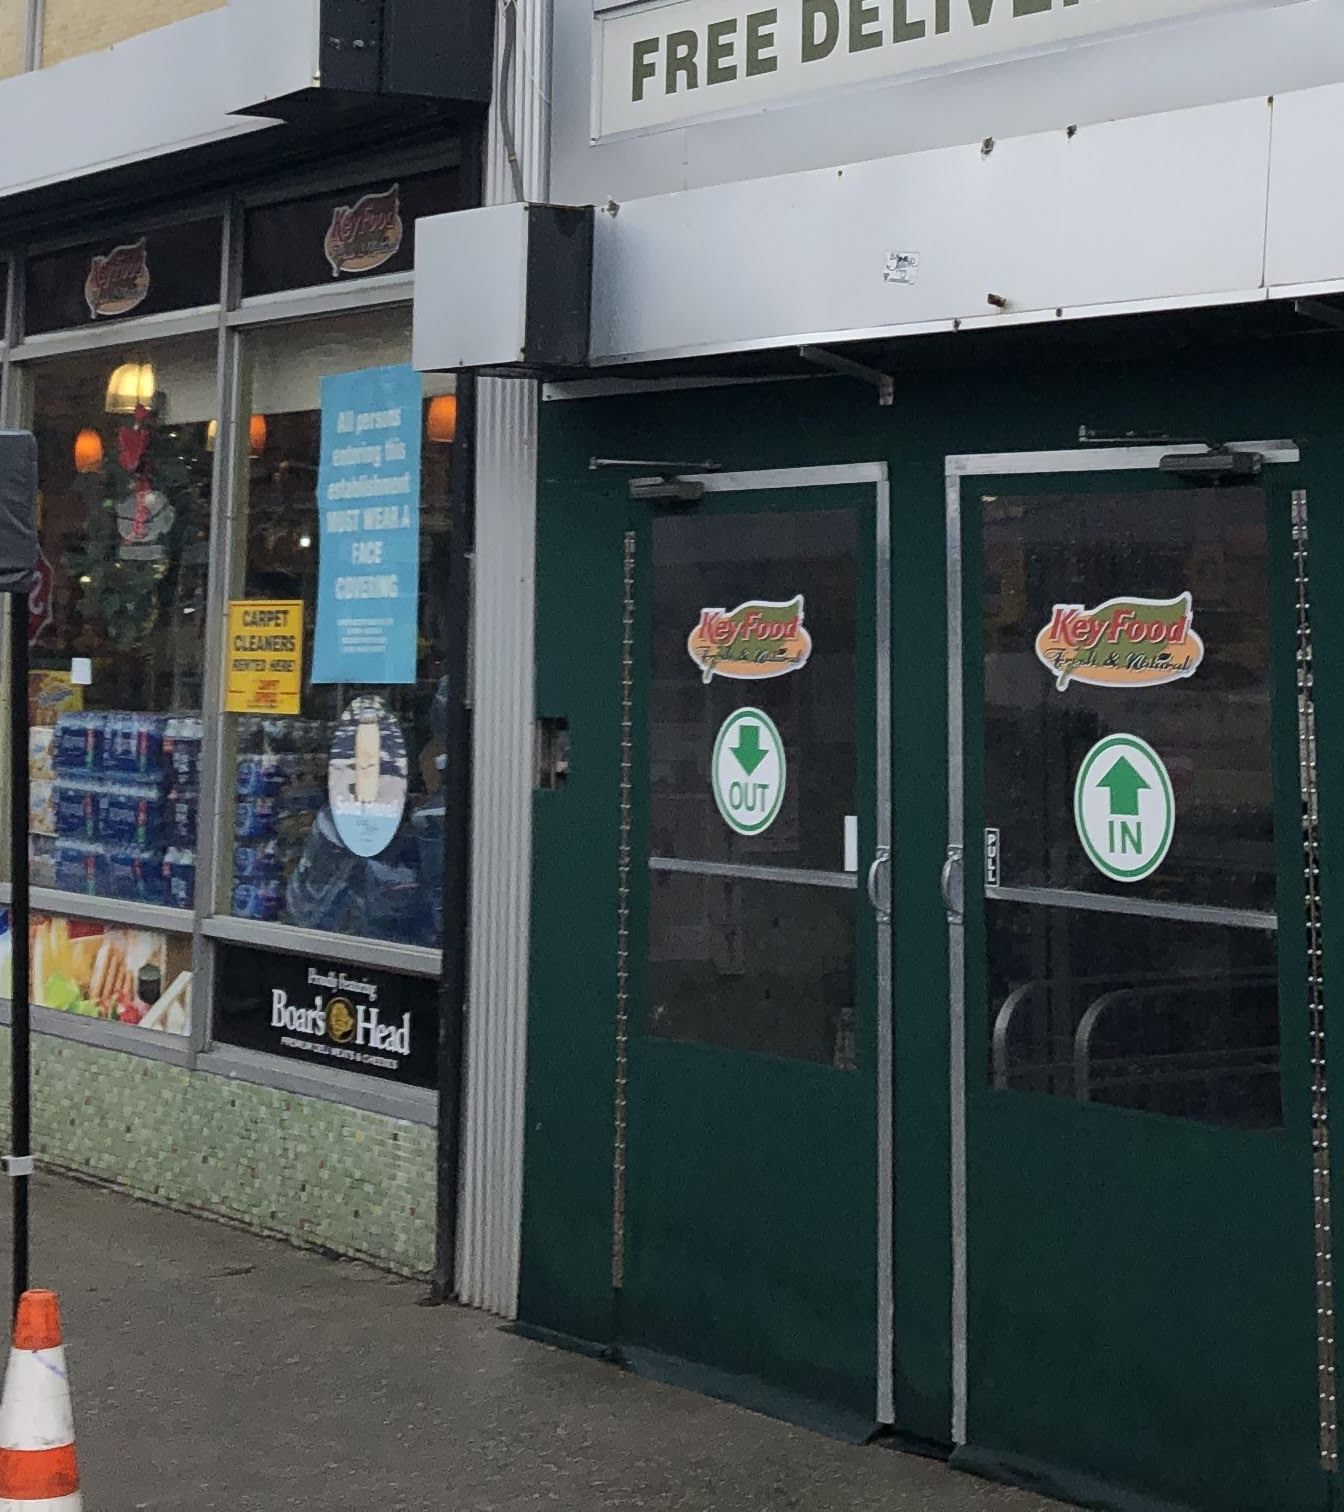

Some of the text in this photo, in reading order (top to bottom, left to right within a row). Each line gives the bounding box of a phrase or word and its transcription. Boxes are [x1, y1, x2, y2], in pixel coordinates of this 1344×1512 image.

[632, 8, 778, 102] FREE
[337, 408, 401, 434] All persons
[326, 504, 410, 532] MUST WEAR A
[352, 541, 383, 564] FACE
[335, 574, 398, 600] COVERING
[242, 609, 289, 627] CARPET
[234, 635, 295, 652] CLEANERS
[1043, 648, 1191, 673] Fresh & Natural
[729, 781, 770, 813] OUT
[1108, 820, 1143, 855] IN
[987, 833, 997, 882] PULL
[271, 988, 411, 1055] Boar's Head
